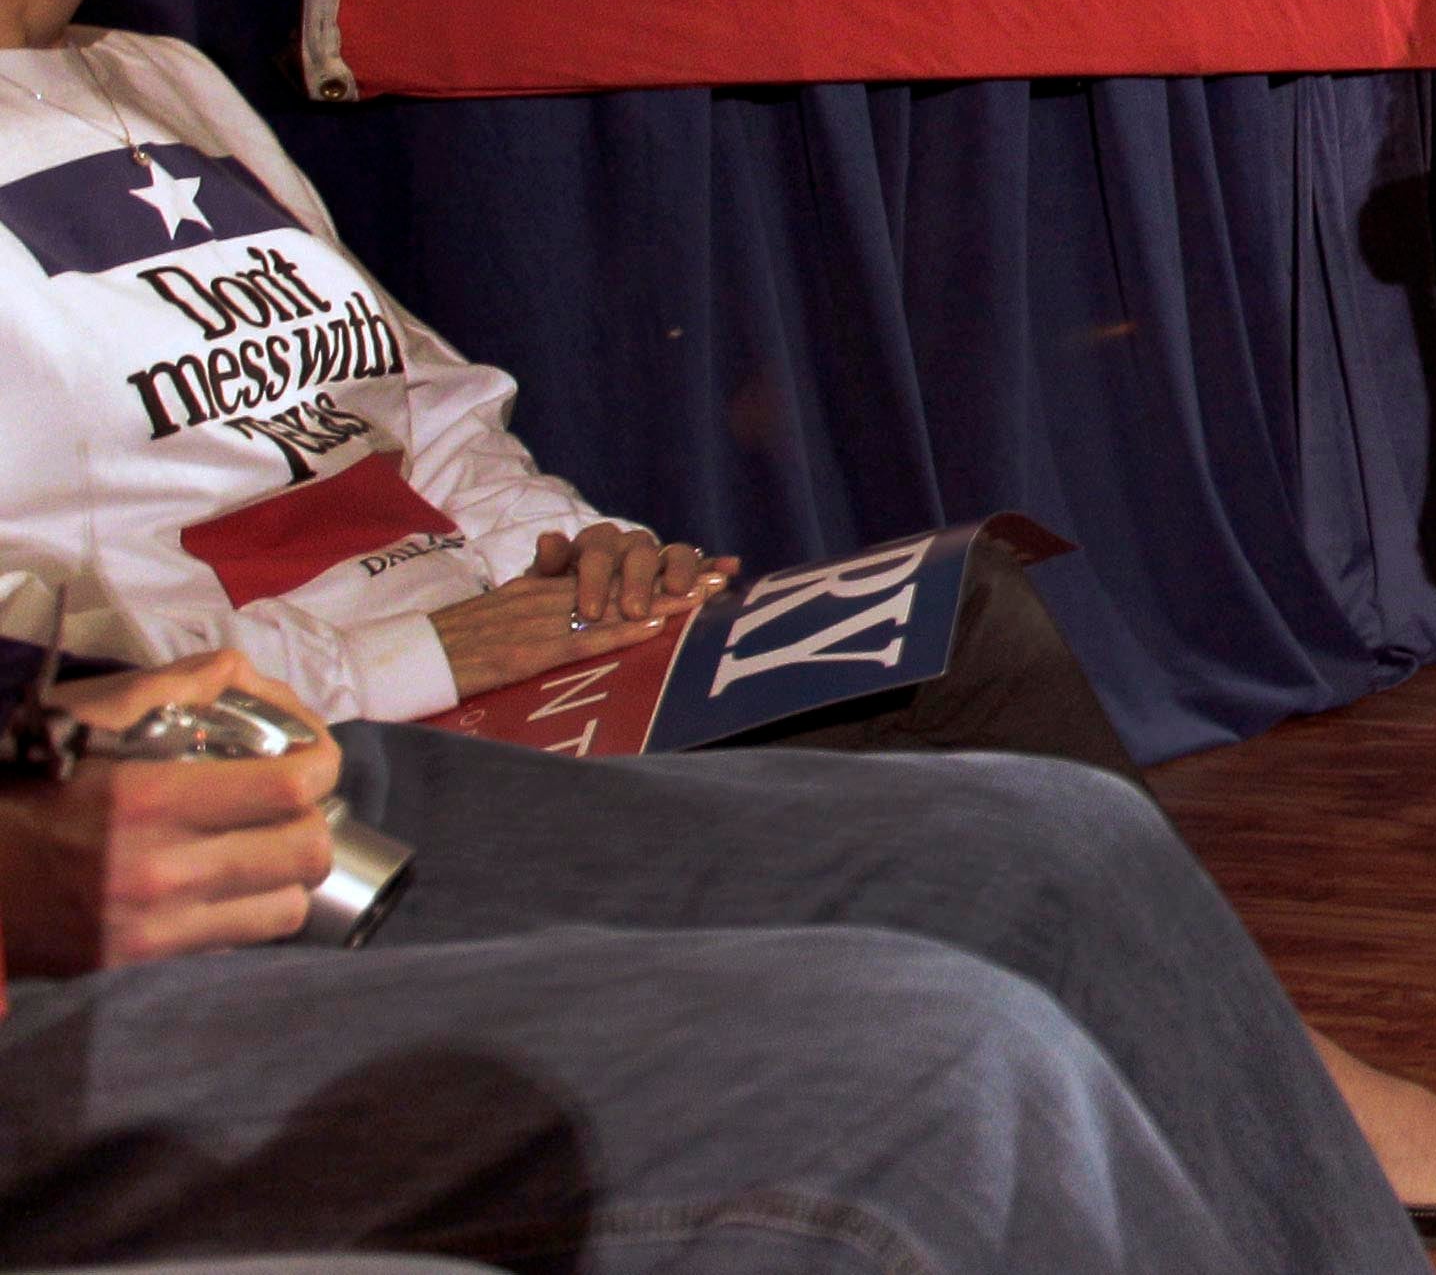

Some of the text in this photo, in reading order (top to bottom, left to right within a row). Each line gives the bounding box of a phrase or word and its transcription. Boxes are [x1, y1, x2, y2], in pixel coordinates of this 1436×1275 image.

[137, 246, 332, 341] Don't
[127, 290, 404, 441] mess with
